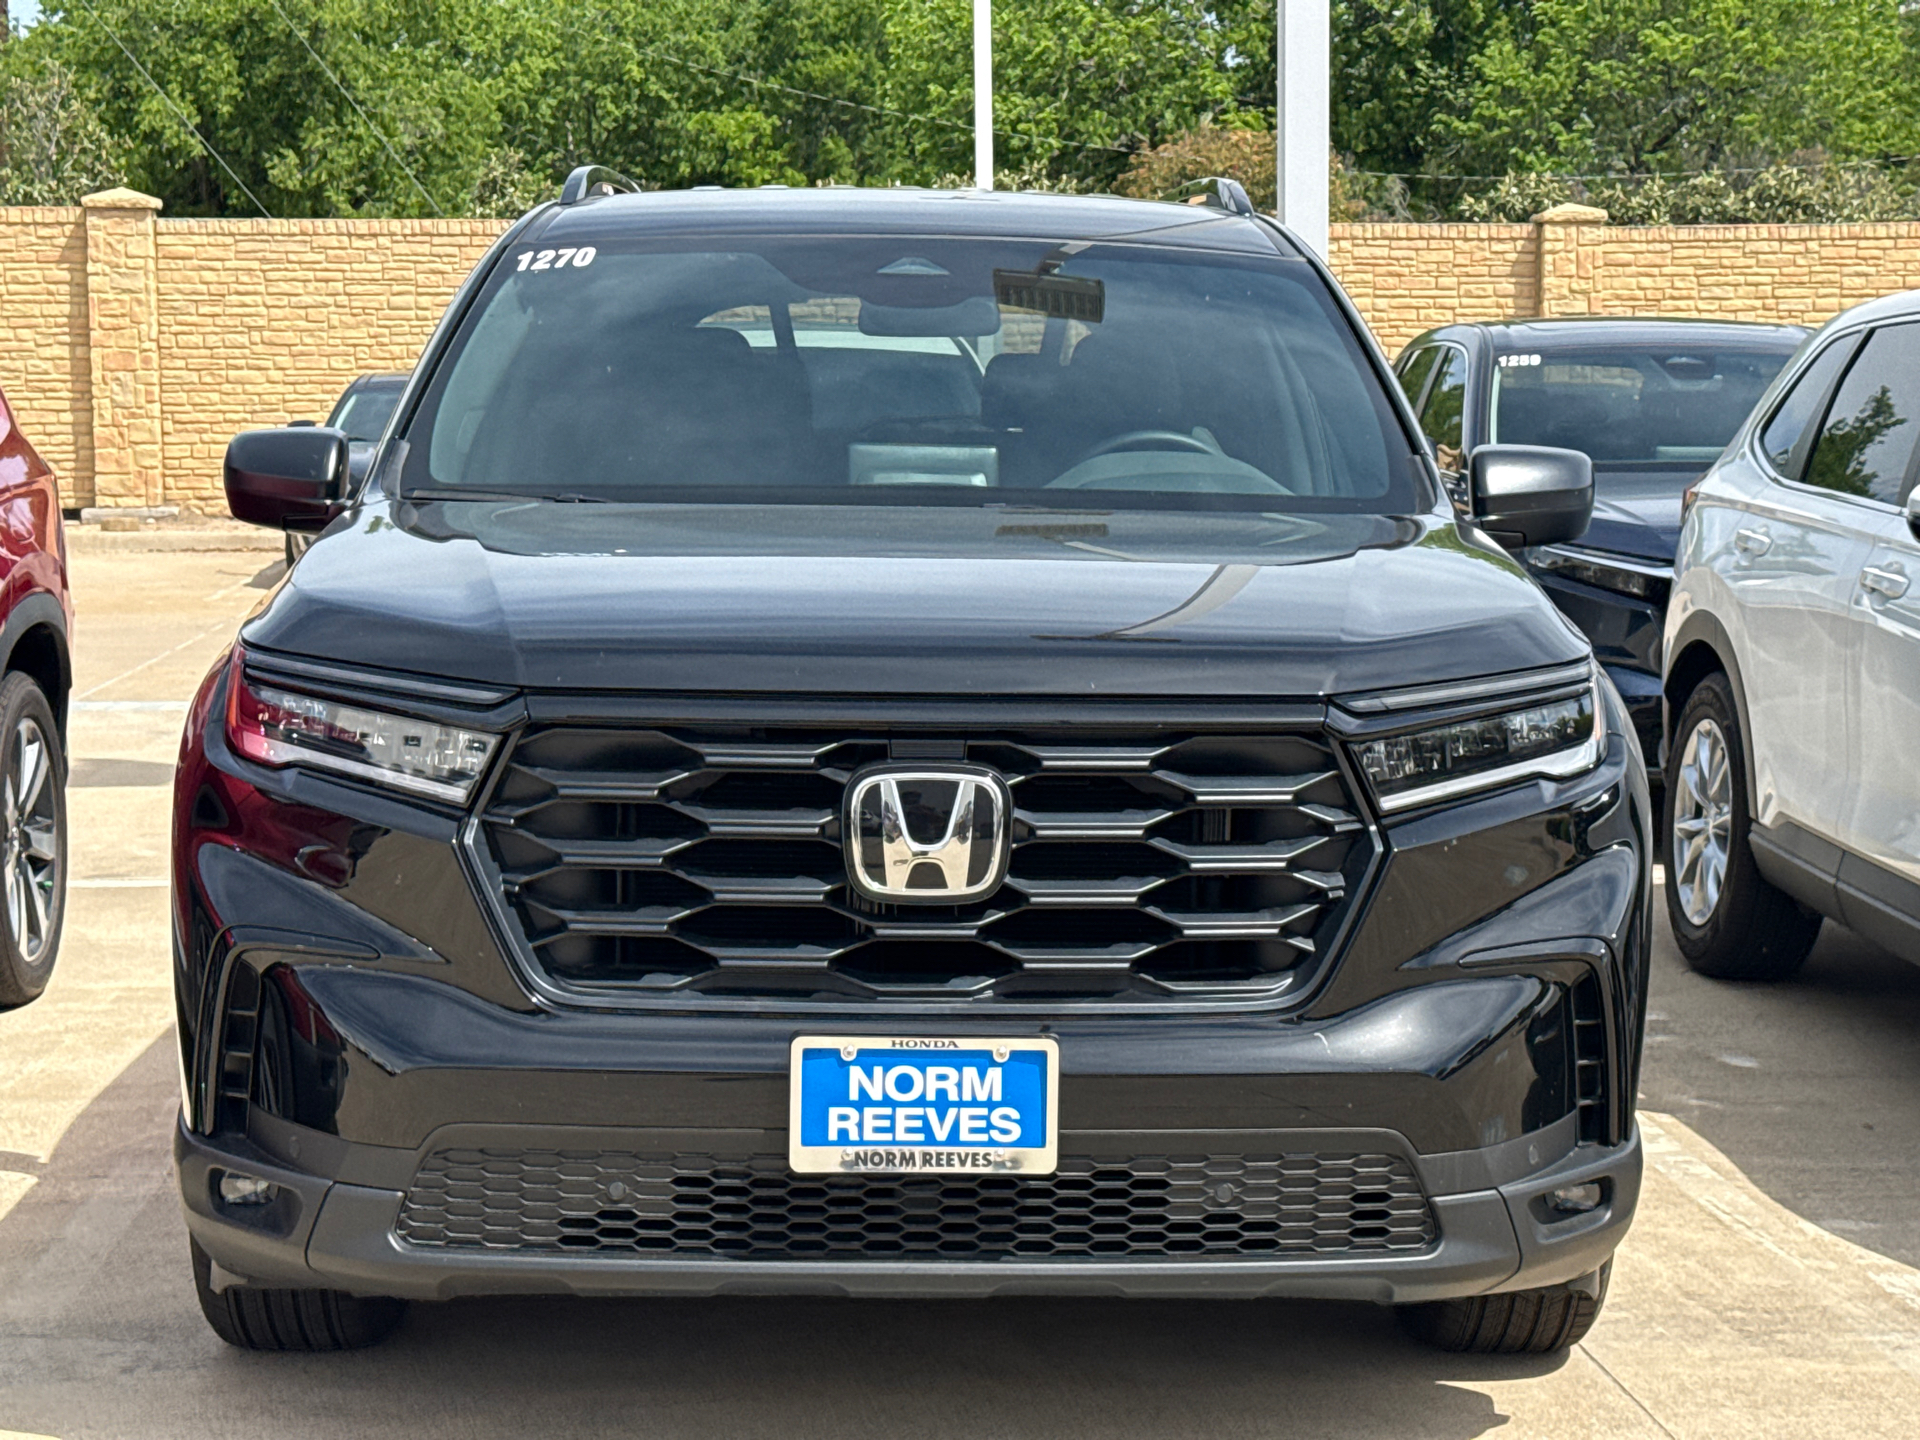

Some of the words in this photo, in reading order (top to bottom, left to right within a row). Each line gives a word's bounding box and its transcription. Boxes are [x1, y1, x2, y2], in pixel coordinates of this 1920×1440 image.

[517, 246, 597, 272] 1270
[891, 1039, 960, 1048] HONDA
[849, 1065, 1003, 1102] NORM
[828, 1106, 1022, 1143] REEVES
[854, 1151, 917, 1168] NORM
[922, 1152, 993, 1168] REEVES
